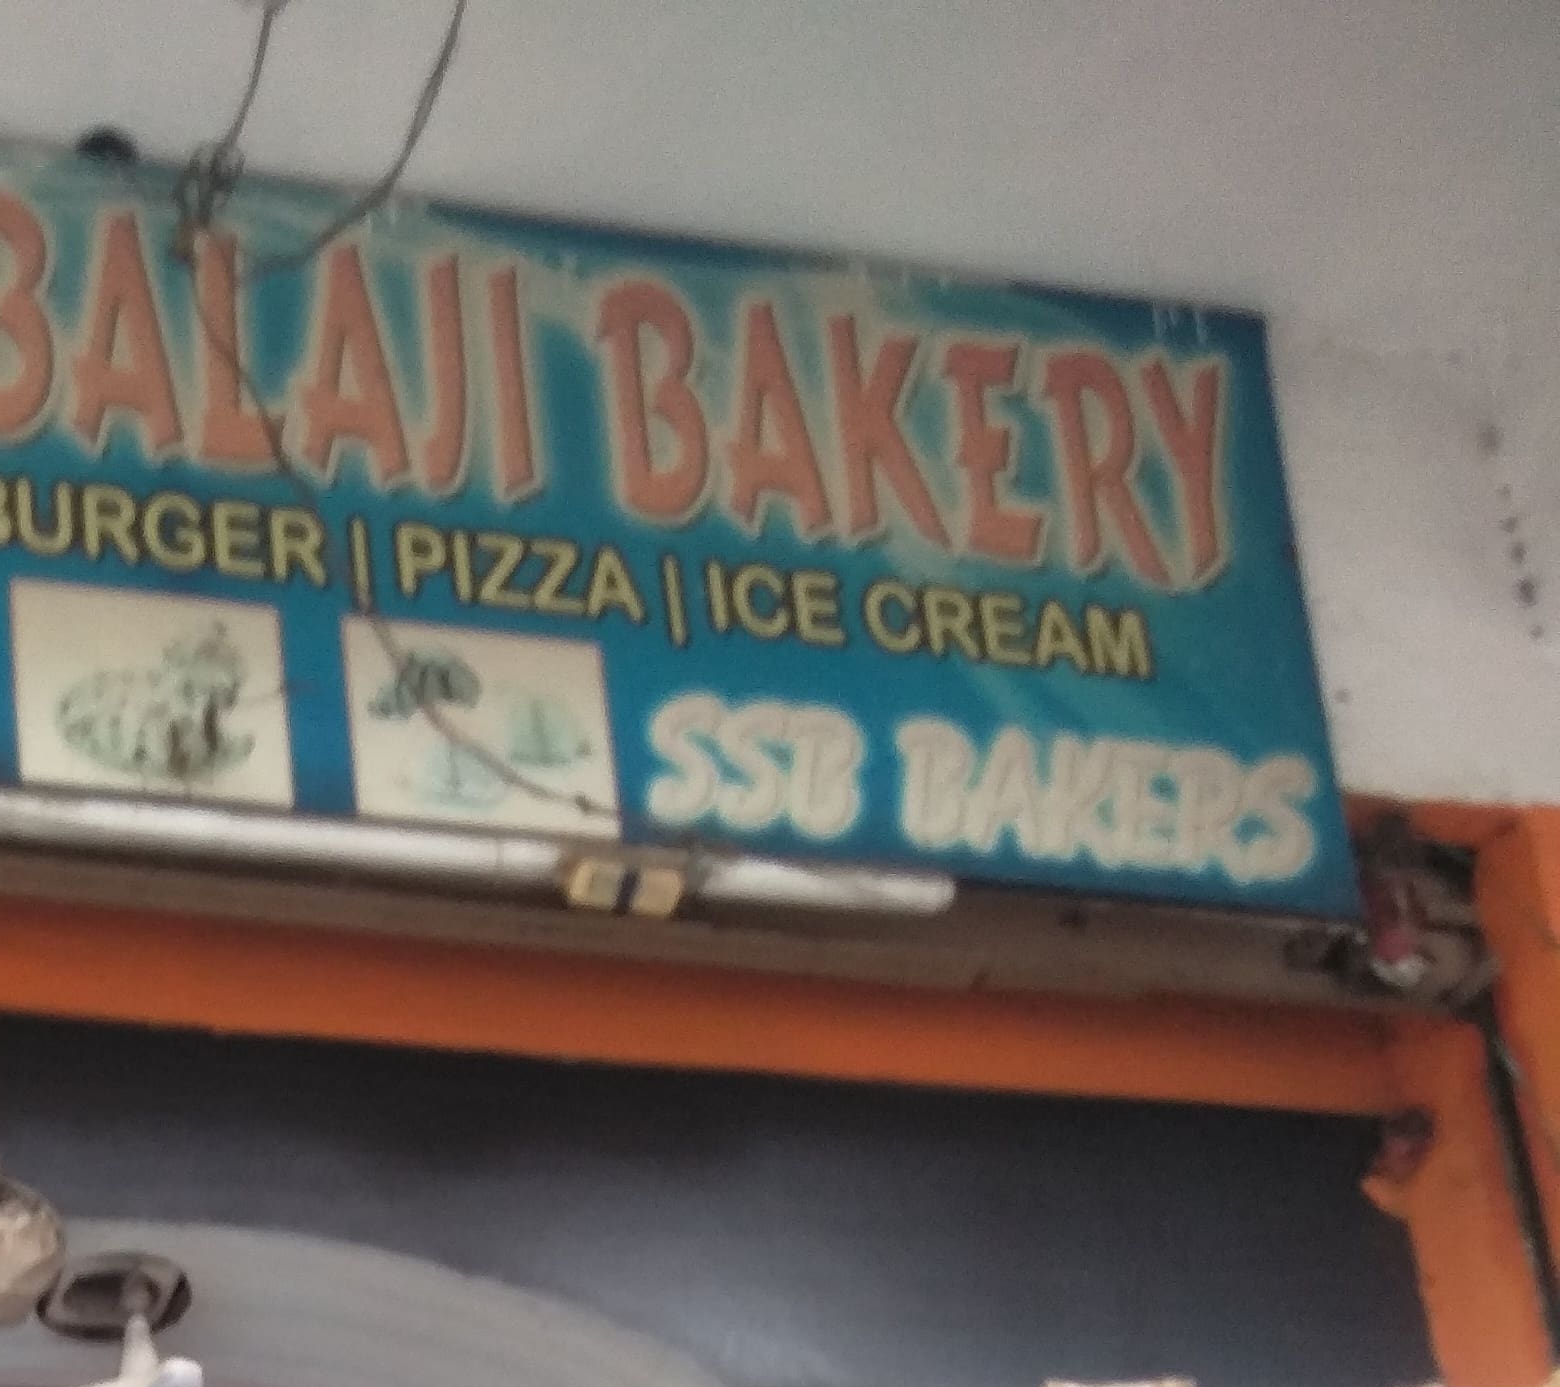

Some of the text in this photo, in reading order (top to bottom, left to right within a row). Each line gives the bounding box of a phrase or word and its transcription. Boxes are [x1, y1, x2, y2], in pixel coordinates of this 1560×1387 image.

[594, 276, 1226, 594] BAKERY
[392, 520, 644, 622] PIZZA
[704, 558, 848, 645] ICE
[862, 578, 1154, 682] CREAM
[646, 692, 1320, 884] SSB BAKERS
